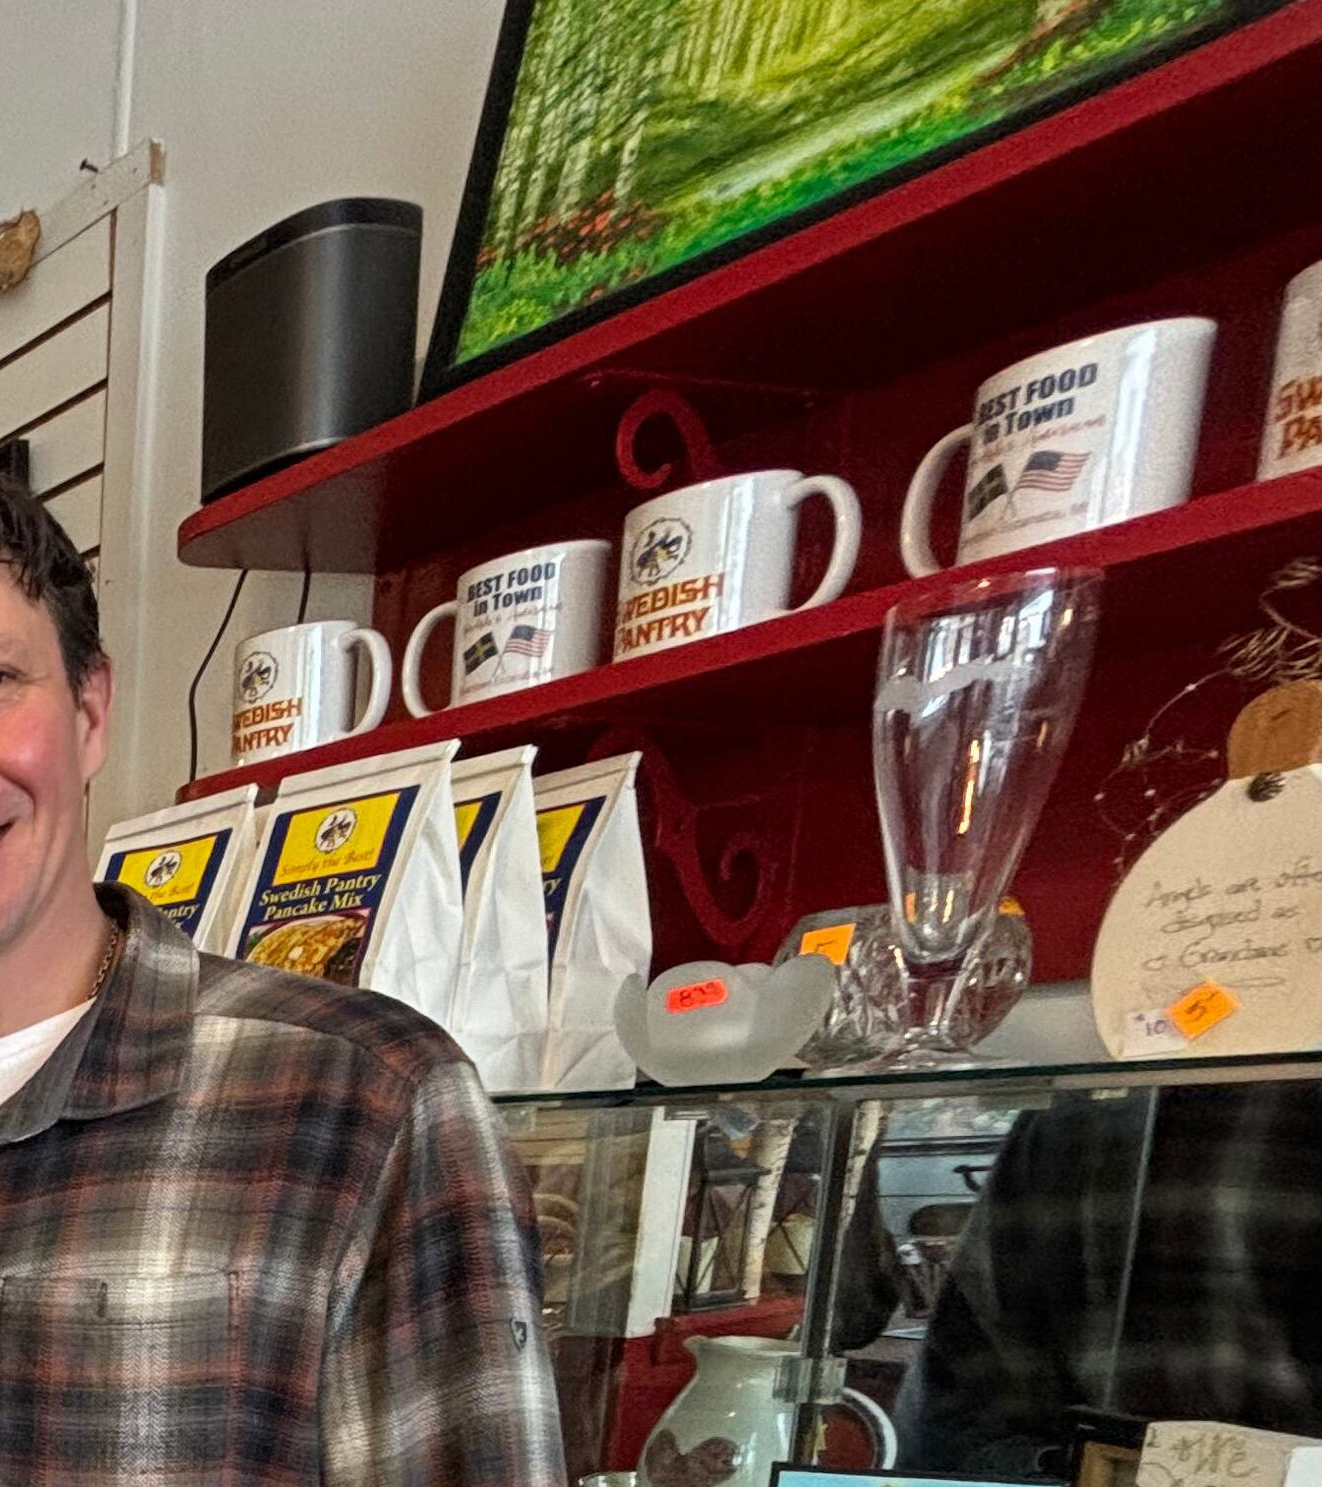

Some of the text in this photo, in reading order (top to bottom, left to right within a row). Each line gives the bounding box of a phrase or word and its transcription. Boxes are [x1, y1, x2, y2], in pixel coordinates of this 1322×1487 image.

[977, 362, 1098, 426] BEST FOOD
[466, 562, 556, 603] BEST FOOD
[619, 572, 724, 624] WEDISH
[233, 697, 303, 732] WEDISH
[232, 722, 295, 756] ANTRY
[259, 873, 382, 906] Swedish Pantry
[263, 891, 364, 921] Pancake Mix
